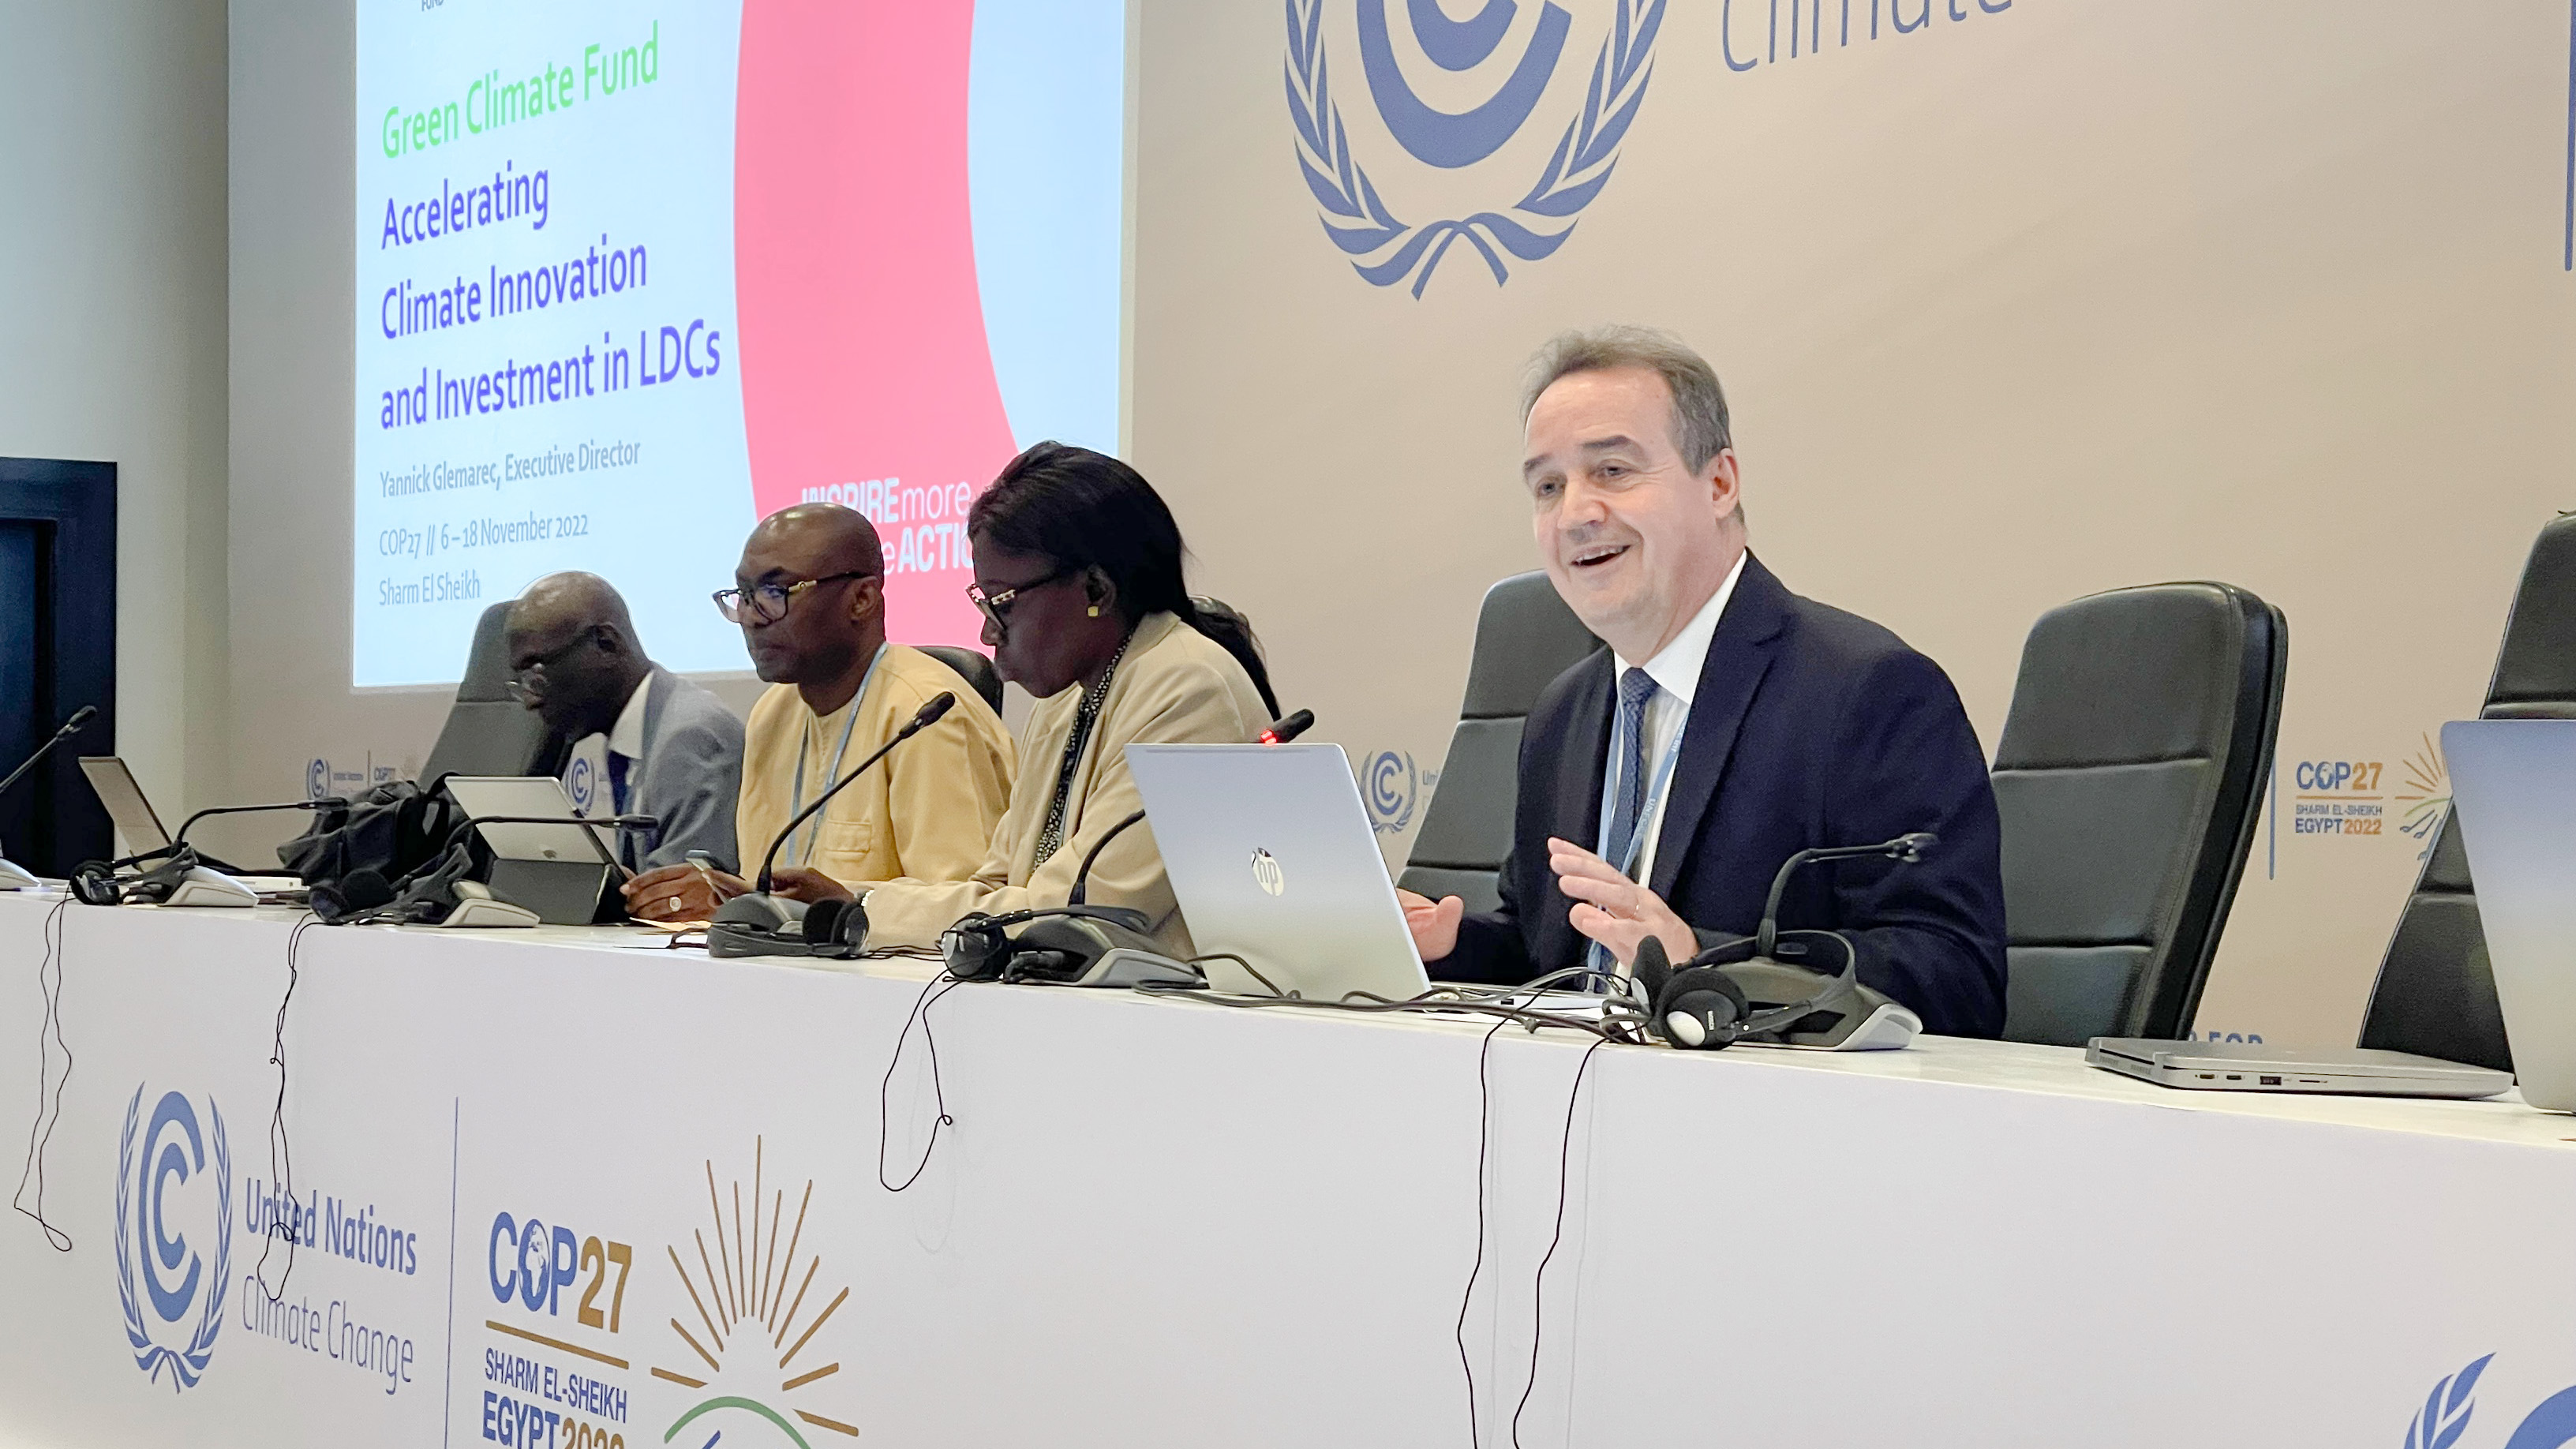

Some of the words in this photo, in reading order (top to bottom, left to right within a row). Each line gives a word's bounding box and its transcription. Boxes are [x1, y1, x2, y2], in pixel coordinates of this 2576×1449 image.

[382, 100, 459, 159] Green
[466, 61, 574, 135] Climate
[582, 19, 658, 101] Fund
[381, 159, 549, 250] Accelerating
[381, 274, 481, 339] Climate
[490, 233, 646, 317] Innovation
[381, 366, 427, 430] and
[436, 344, 594, 421] Investment
[603, 331, 629, 392] in
[640, 318, 720, 387] LDCs
[380, 464, 430, 498] Yannick
[433, 461, 500, 491] Glemarec,
[505, 444, 575, 481] Executive
[578, 439, 641, 472] Director
[902, 481, 972, 521] more
[379, 528, 421, 560] COP27
[481, 511, 552, 546] November
[556, 514, 589, 538] 2022
[379, 578, 418, 605] Sharm
[422, 574, 433, 603] El
[436, 569, 481, 602] Sheikh
[2296, 761, 2383, 790] COP27
[2296, 803, 2329, 814] SHARM
[2295, 818, 2342, 833] EGYPT
[2344, 818, 2382, 835] 2022
[246, 1177, 317, 1249] United
[325, 1196, 417, 1275] Nations
[489, 1211, 632, 1333] COP27
[242, 1275, 320, 1352] Climate
[328, 1300, 414, 1395] Change
[485, 1347, 538, 1395] SHARM
[544, 1366, 627, 1423] EL-SHEIKH
[482, 1390, 560, 1449] EGYPT
